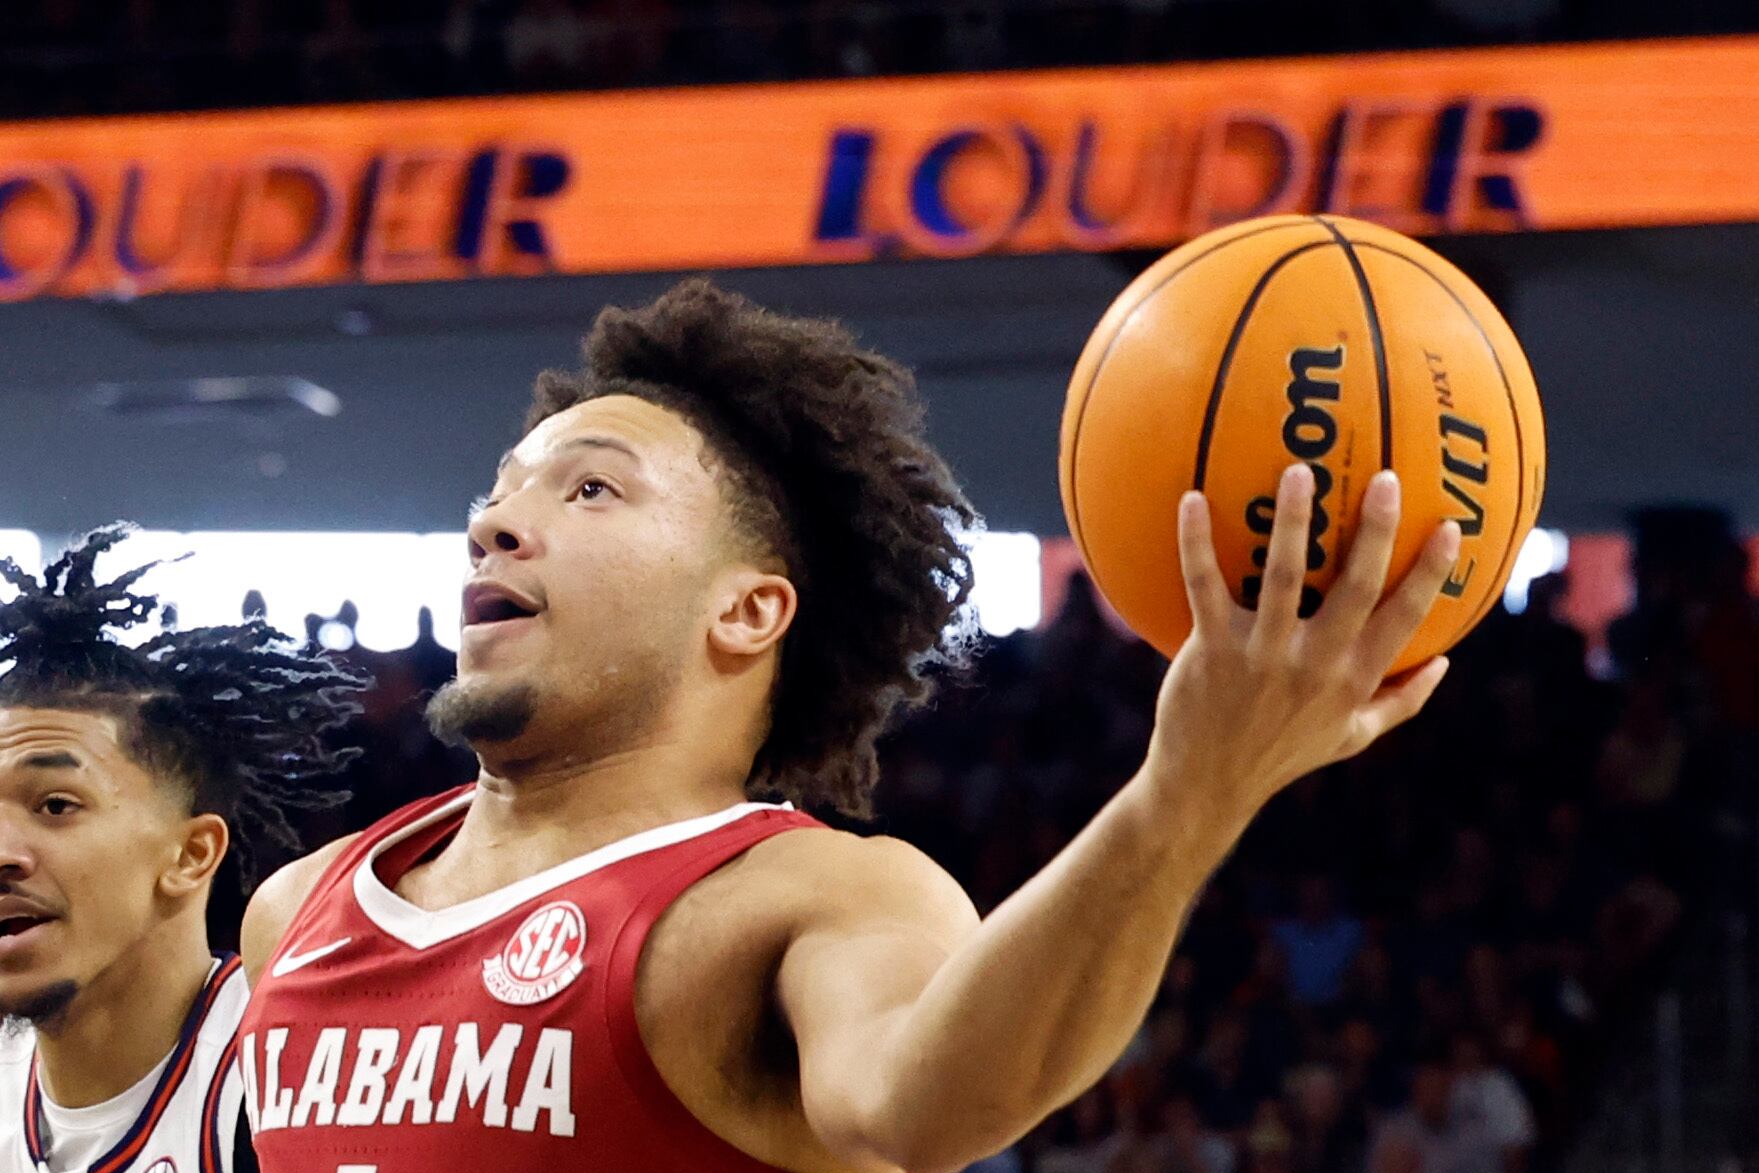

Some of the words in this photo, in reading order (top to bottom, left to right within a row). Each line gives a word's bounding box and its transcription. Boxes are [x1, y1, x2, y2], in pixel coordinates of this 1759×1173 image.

[807, 95, 1548, 258] LOUDER
[510, 907, 581, 979] SEC
[241, 1022, 576, 1137] ALABAMA
